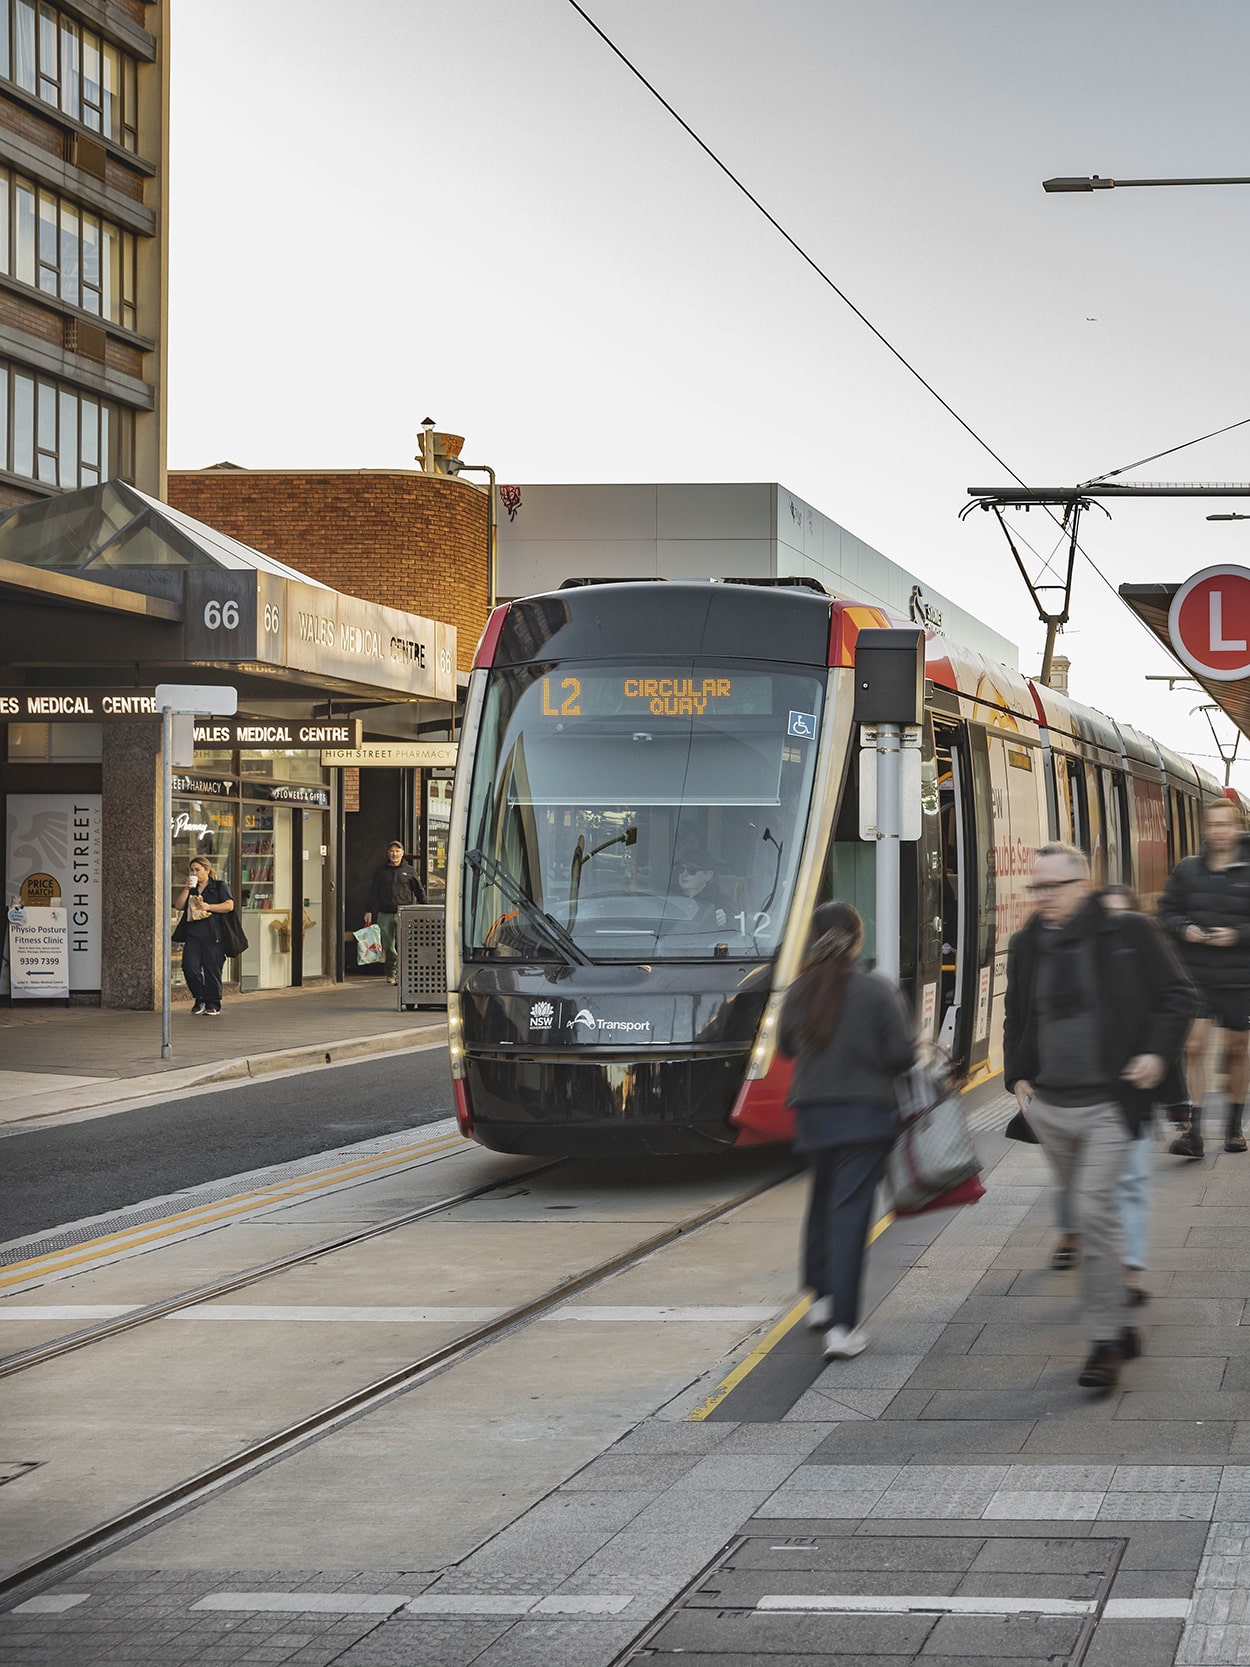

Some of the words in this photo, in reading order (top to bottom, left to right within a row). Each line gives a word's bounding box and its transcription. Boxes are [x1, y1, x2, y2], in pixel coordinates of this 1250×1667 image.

[204, 600, 239, 630] 66
[264, 603, 280, 634] 66
[1209, 591, 1247, 651] L
[298, 612, 336, 648] WALES
[340, 623, 385, 660] MEDICAL
[390, 636, 426, 669] CENTRE
[440, 649, 452, 675] 66
[0, 696, 19, 714] ES
[28, 696, 94, 714] MEDICAL
[543, 677, 581, 716] L2
[624, 679, 731, 697] CIRCULAR
[650, 697, 708, 715] QUAY
[237, 727, 292, 742] MEDICAL
[299, 727, 349, 742] CENTRE
[325, 750, 352, 758] HIGH
[356, 750, 392, 758] STREET
[395, 750, 451, 758] PHARMACY
[186, 779, 221, 793] PHARMACY
[276, 790, 303, 800] FLOWERS
[310, 792, 326, 802] GIFTS
[73, 805, 90, 884] STREET
[994, 835, 1016, 876] ouble
[27, 879, 54, 888] PRICE
[11, 925, 36, 934] Physio
[38, 925, 67, 933] Posture
[73, 894, 89, 952] HIGH
[734, 911, 771, 937] 12
[14, 936, 41, 944] Fitness
[43, 936, 63, 944] Clinic
[20, 957, 39, 965] 9399
[41, 957, 60, 965] 7399
[530, 1017, 553, 1026] NSW
[597, 1019, 650, 1032] Transport
